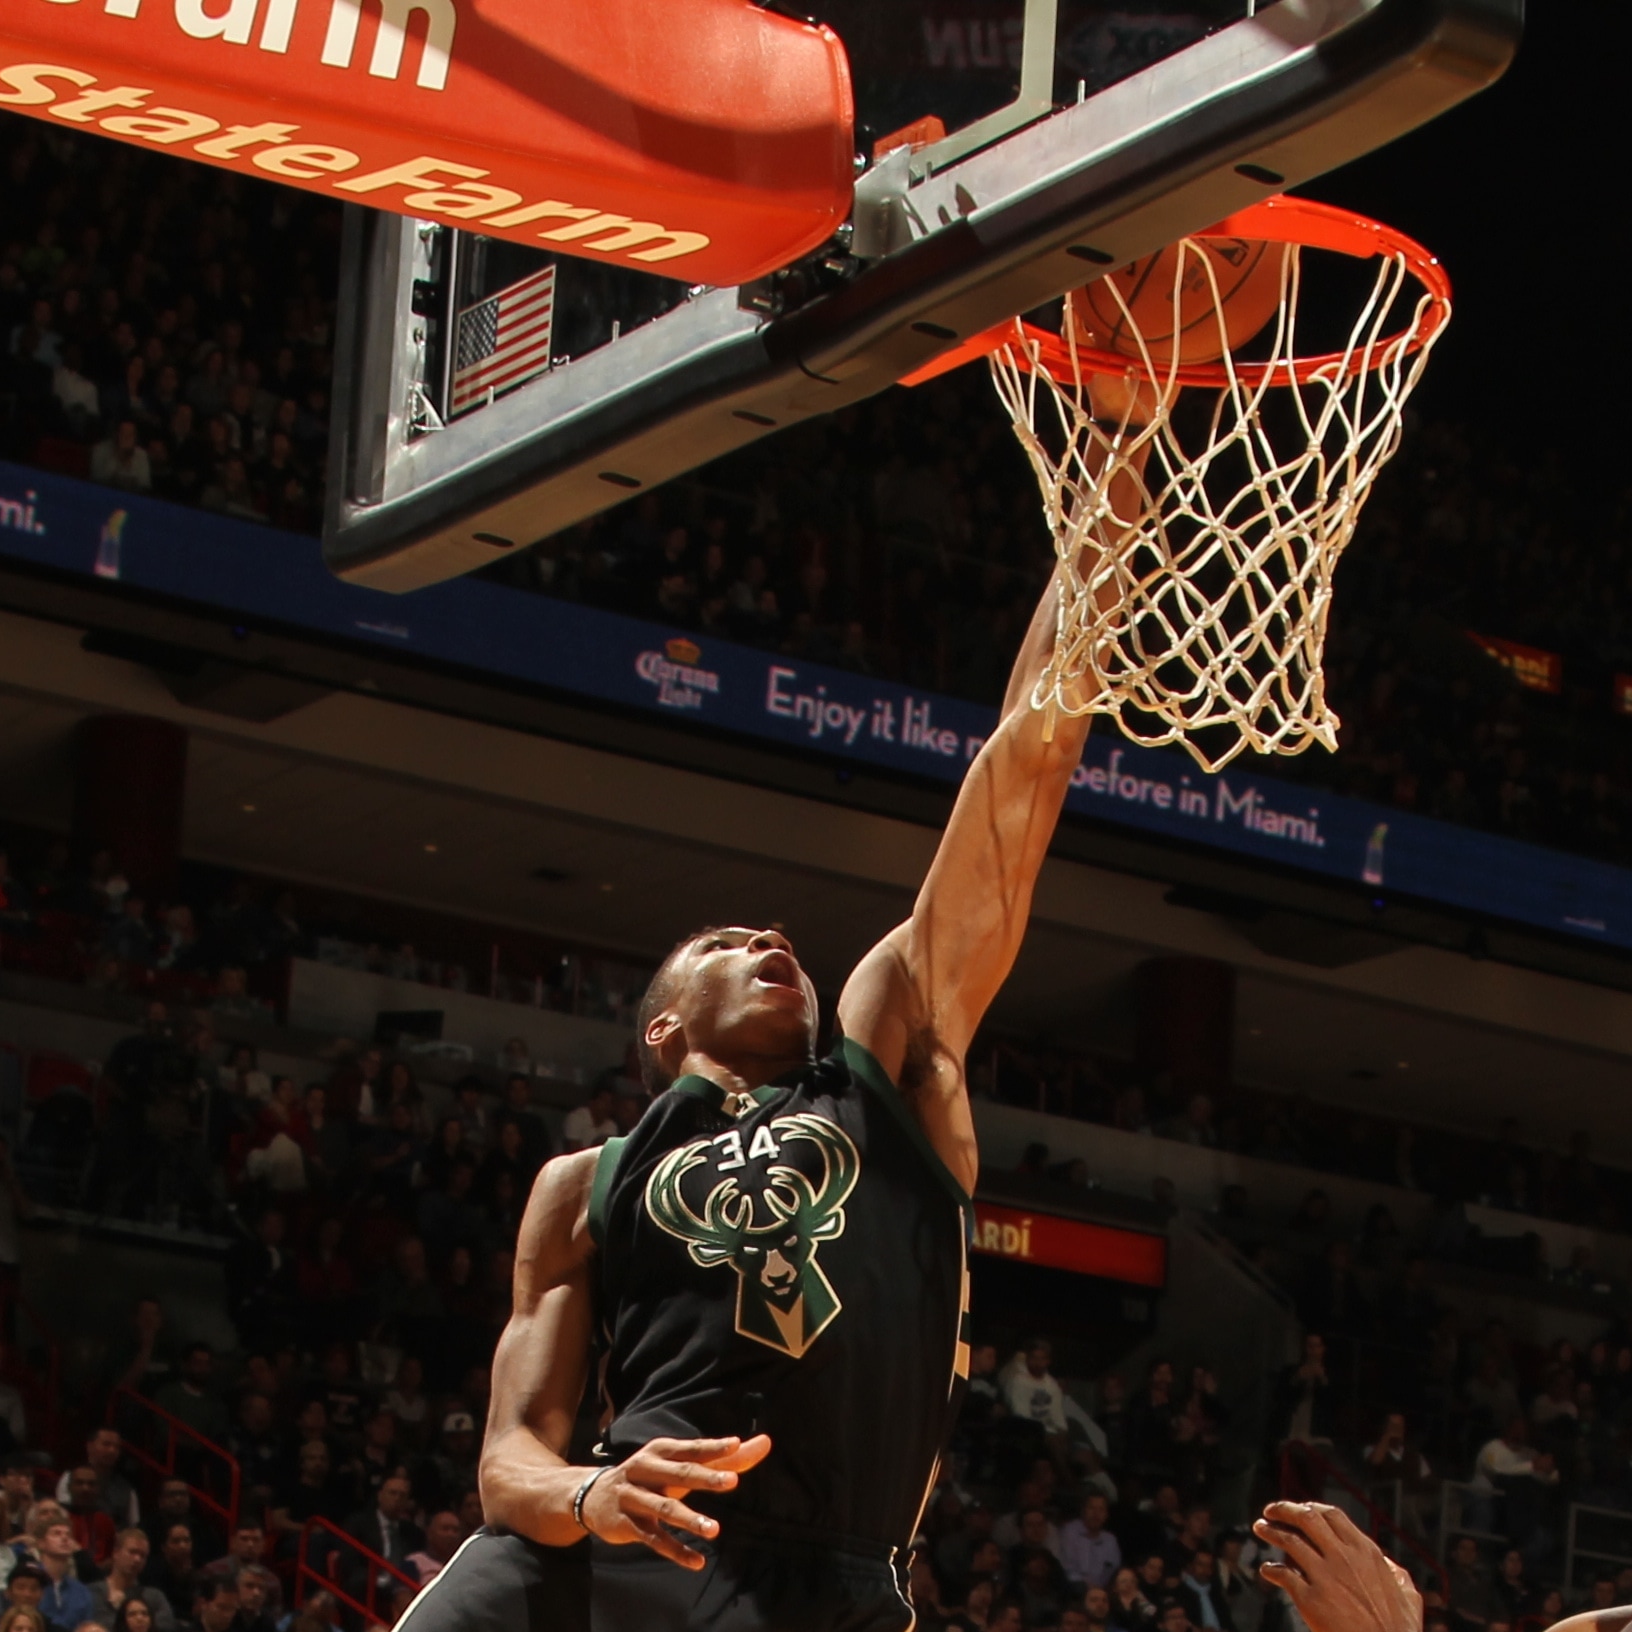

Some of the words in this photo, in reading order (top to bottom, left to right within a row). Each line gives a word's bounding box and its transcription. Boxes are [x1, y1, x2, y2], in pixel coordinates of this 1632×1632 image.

[333, 156, 710, 263] Farm
[767, 665, 867, 746] Enjoy
[870, 706, 898, 744] it
[902, 698, 961, 756] like
[1178, 776, 1209, 814] in
[1214, 779, 1325, 848] Miami.
[713, 1124, 781, 1173] 34
